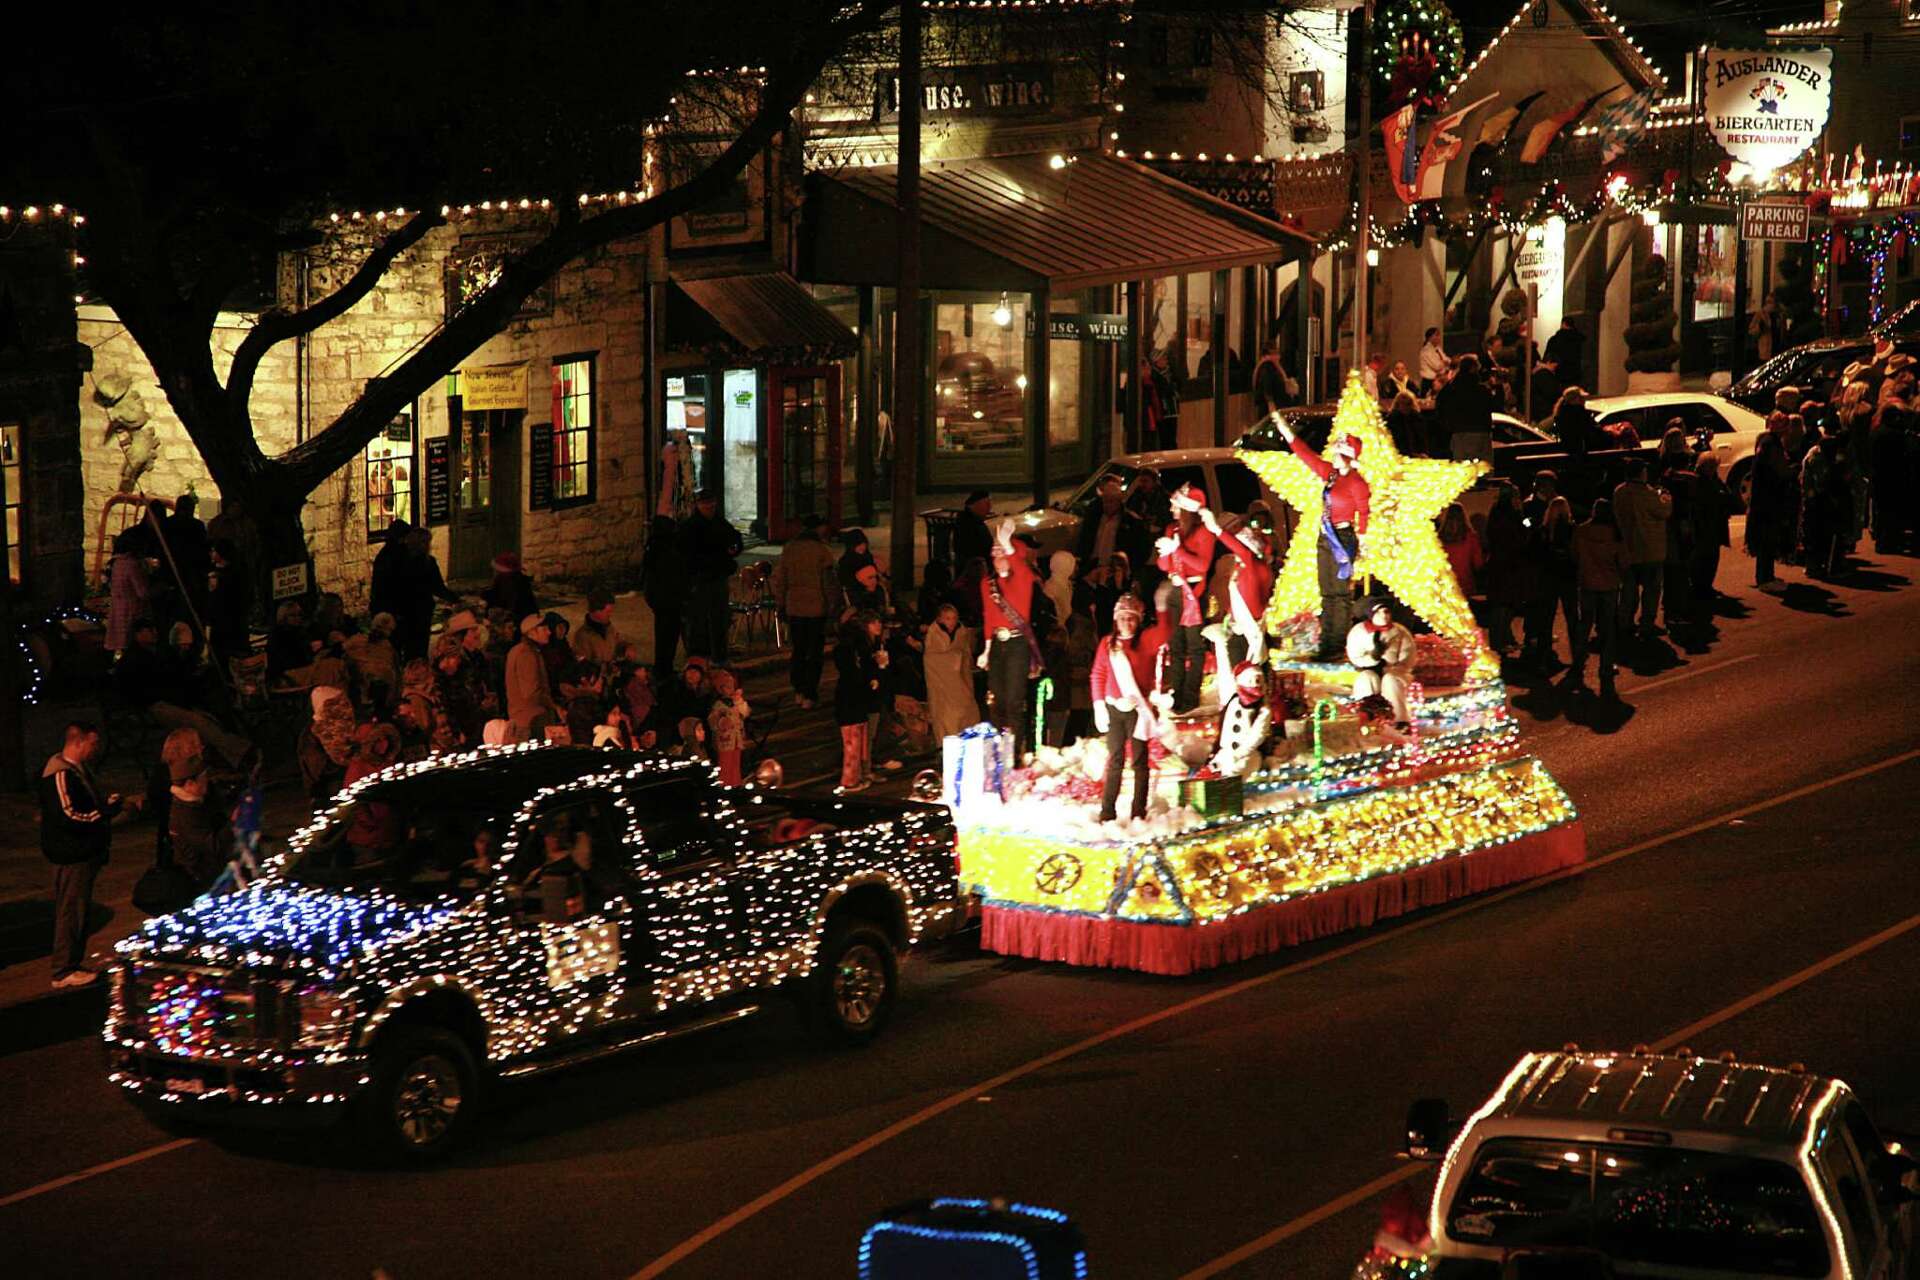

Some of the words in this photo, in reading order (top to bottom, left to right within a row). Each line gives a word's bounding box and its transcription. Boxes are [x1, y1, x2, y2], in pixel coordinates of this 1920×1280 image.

[1716, 56, 1822, 90] AUSLANDER
[893, 78, 971, 112] use.
[1715, 115, 1815, 132] BIERGARTEN
[1727, 134, 1800, 145] RESTAURANT
[1748, 207, 1805, 223] PARKING
[1749, 223, 1762, 236] IN
[1766, 223, 1801, 237] REAR
[1027, 317, 1080, 334] huse.
